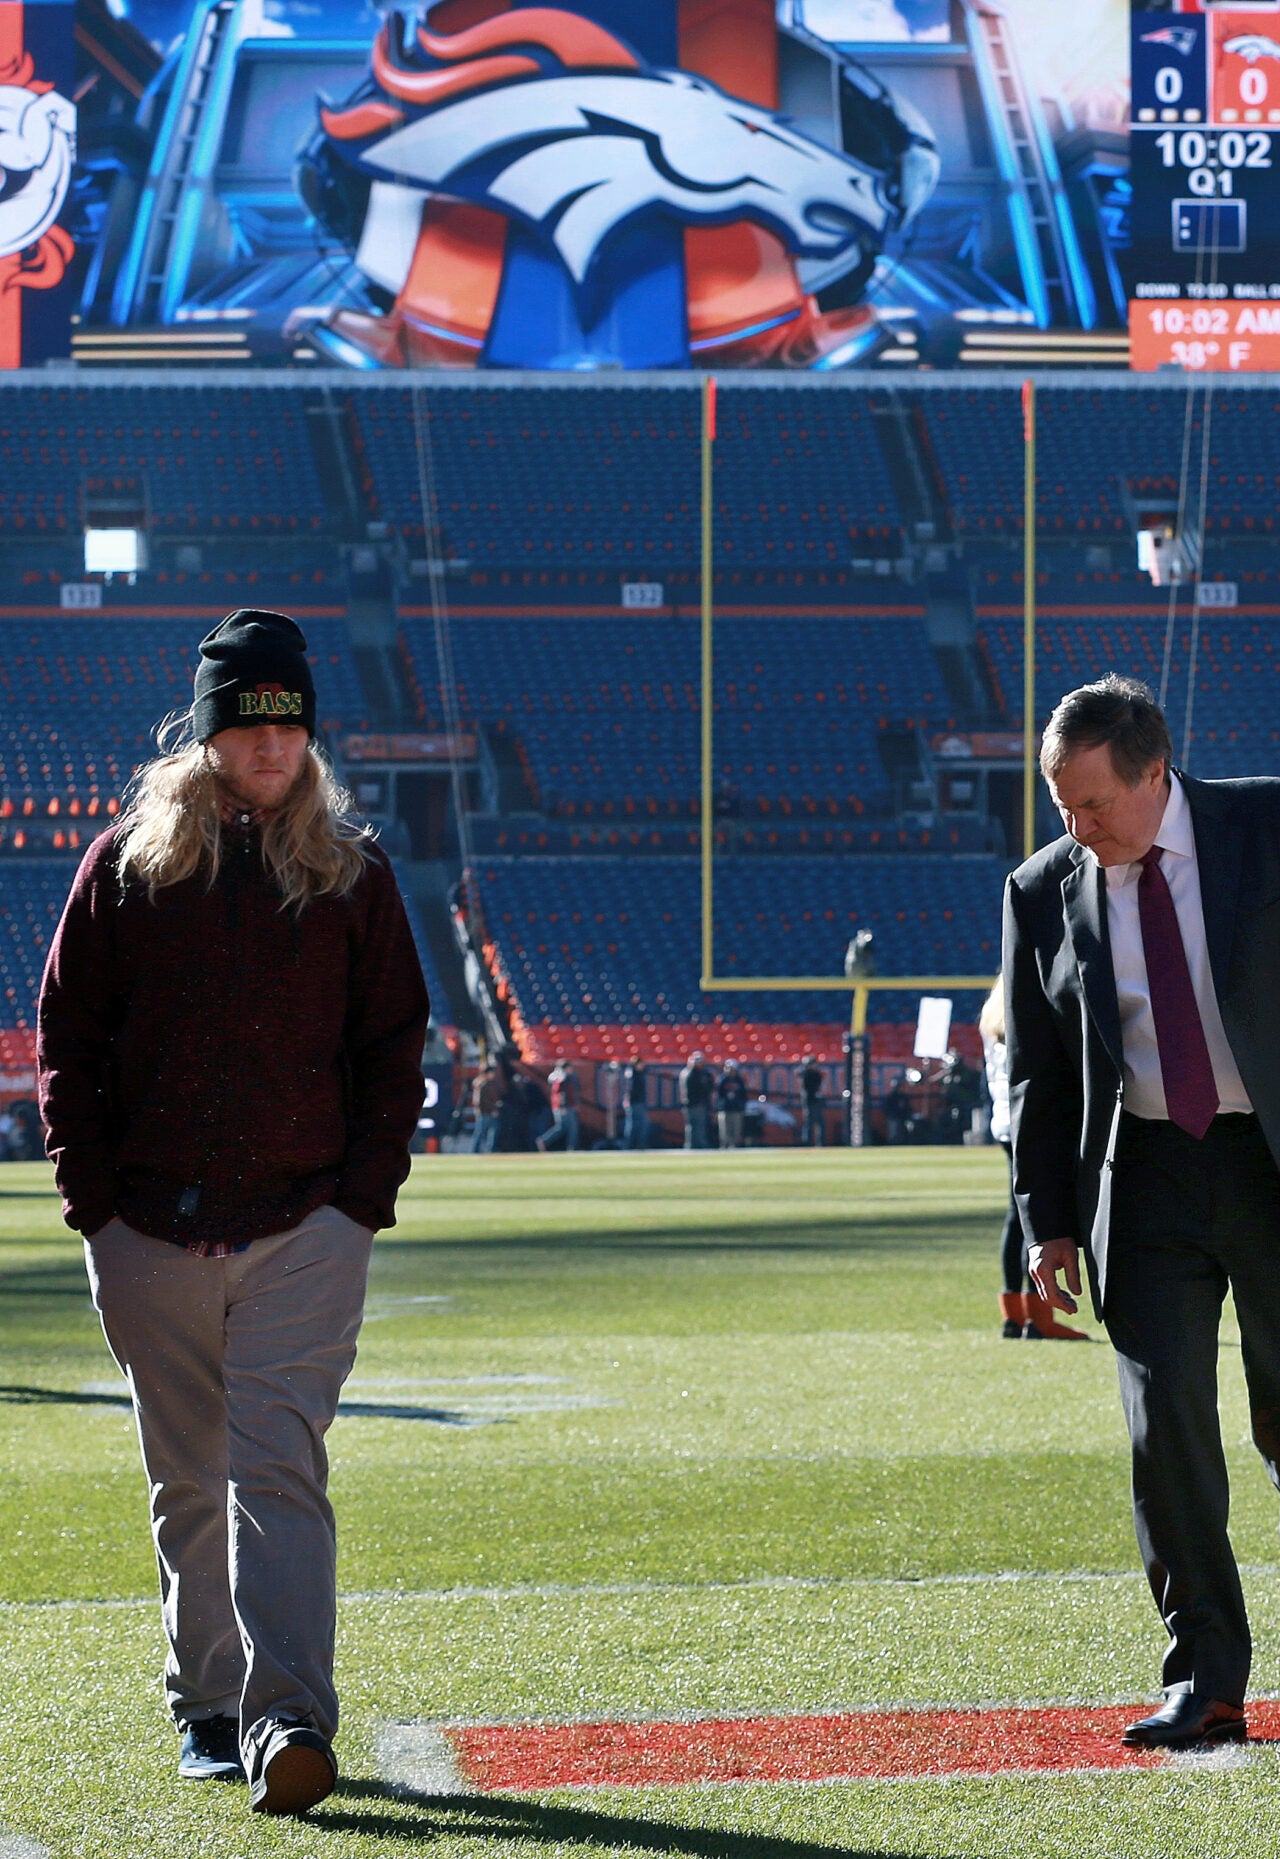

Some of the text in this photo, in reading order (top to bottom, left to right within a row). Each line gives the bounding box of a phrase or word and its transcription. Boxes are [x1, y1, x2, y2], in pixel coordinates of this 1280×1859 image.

[1154, 66, 1184, 104] 0
[1238, 67, 1269, 105] 0
[1155, 131, 1272, 168] 10:02
[1187, 167, 1234, 197] Q1
[1149, 307, 1230, 335] 10:02
[238, 691, 303, 716] BASS
